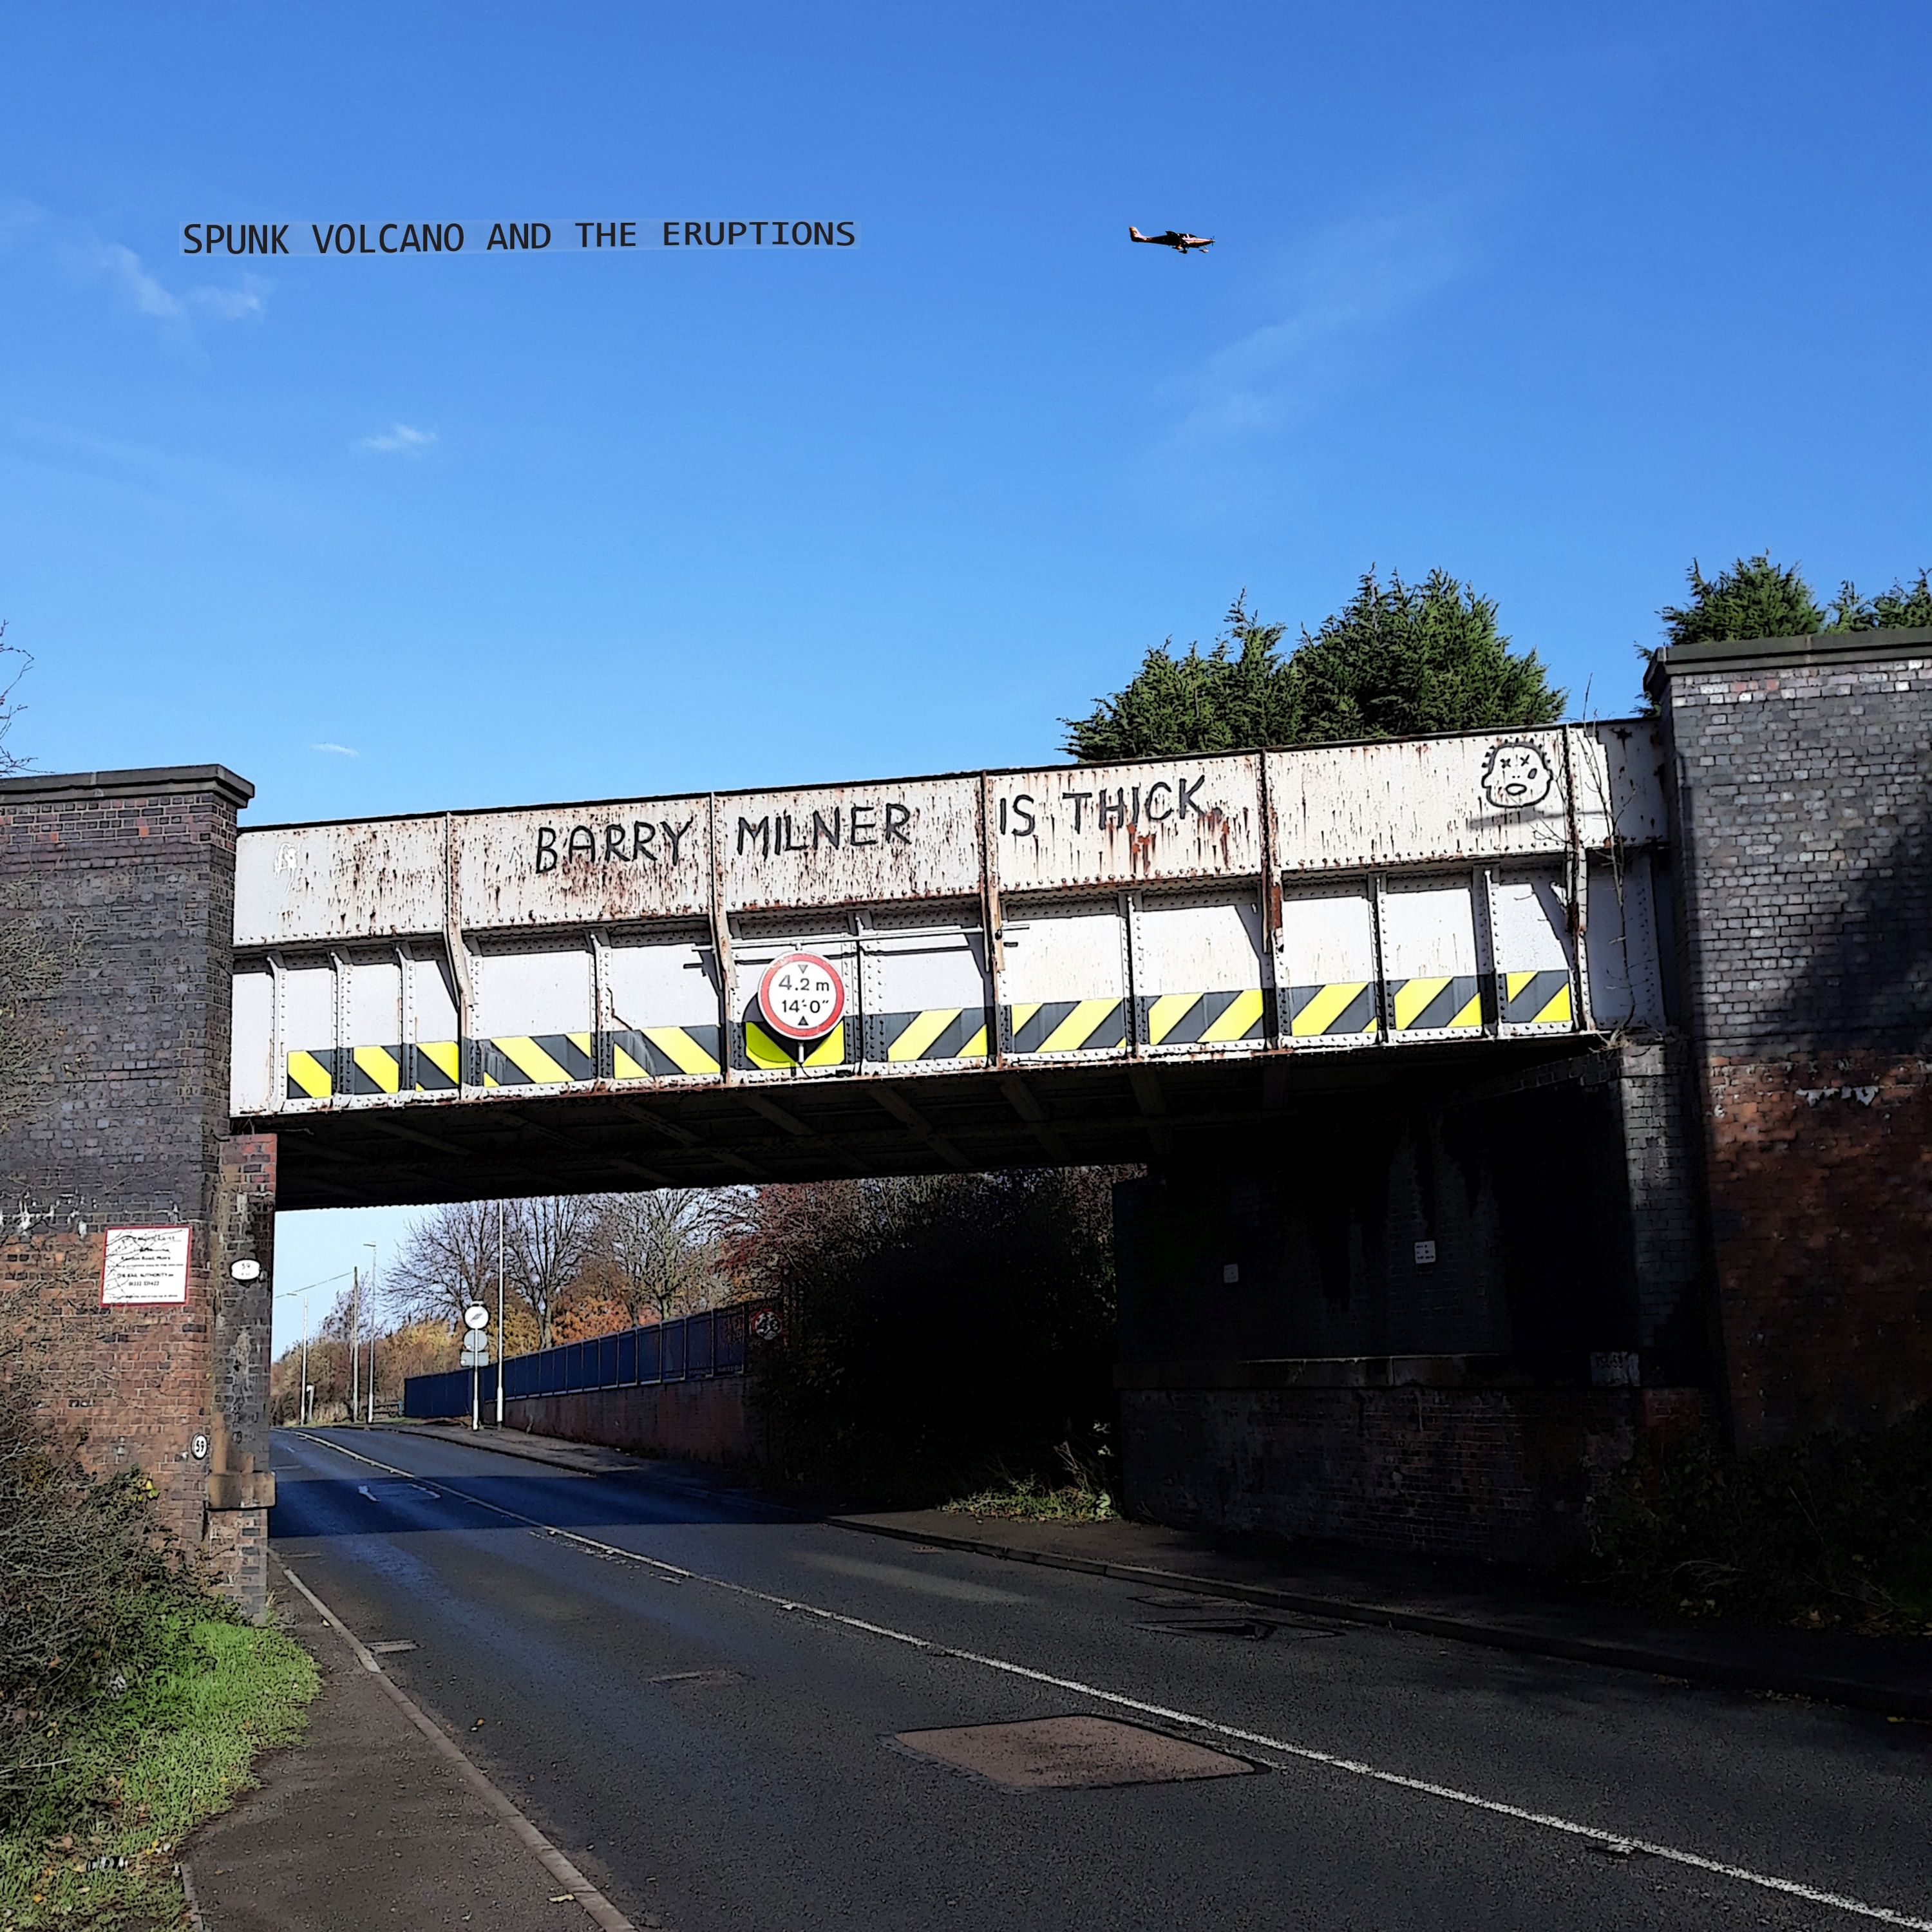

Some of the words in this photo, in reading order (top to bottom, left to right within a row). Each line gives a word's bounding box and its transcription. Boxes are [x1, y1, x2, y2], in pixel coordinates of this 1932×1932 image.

[184, 223, 290, 254] SPUNK
[312, 223, 464, 254] VOLCANO
[486, 223, 551, 251] AND
[575, 222, 636, 248] THE
[663, 221, 855, 247] ERUPTIONS
[535, 815, 694, 875] BARRY
[737, 803, 912, 860] MILNER
[999, 794, 1036, 837] IS
[778, 974, 810, 990] 4.2
[815, 981, 830, 992] m
